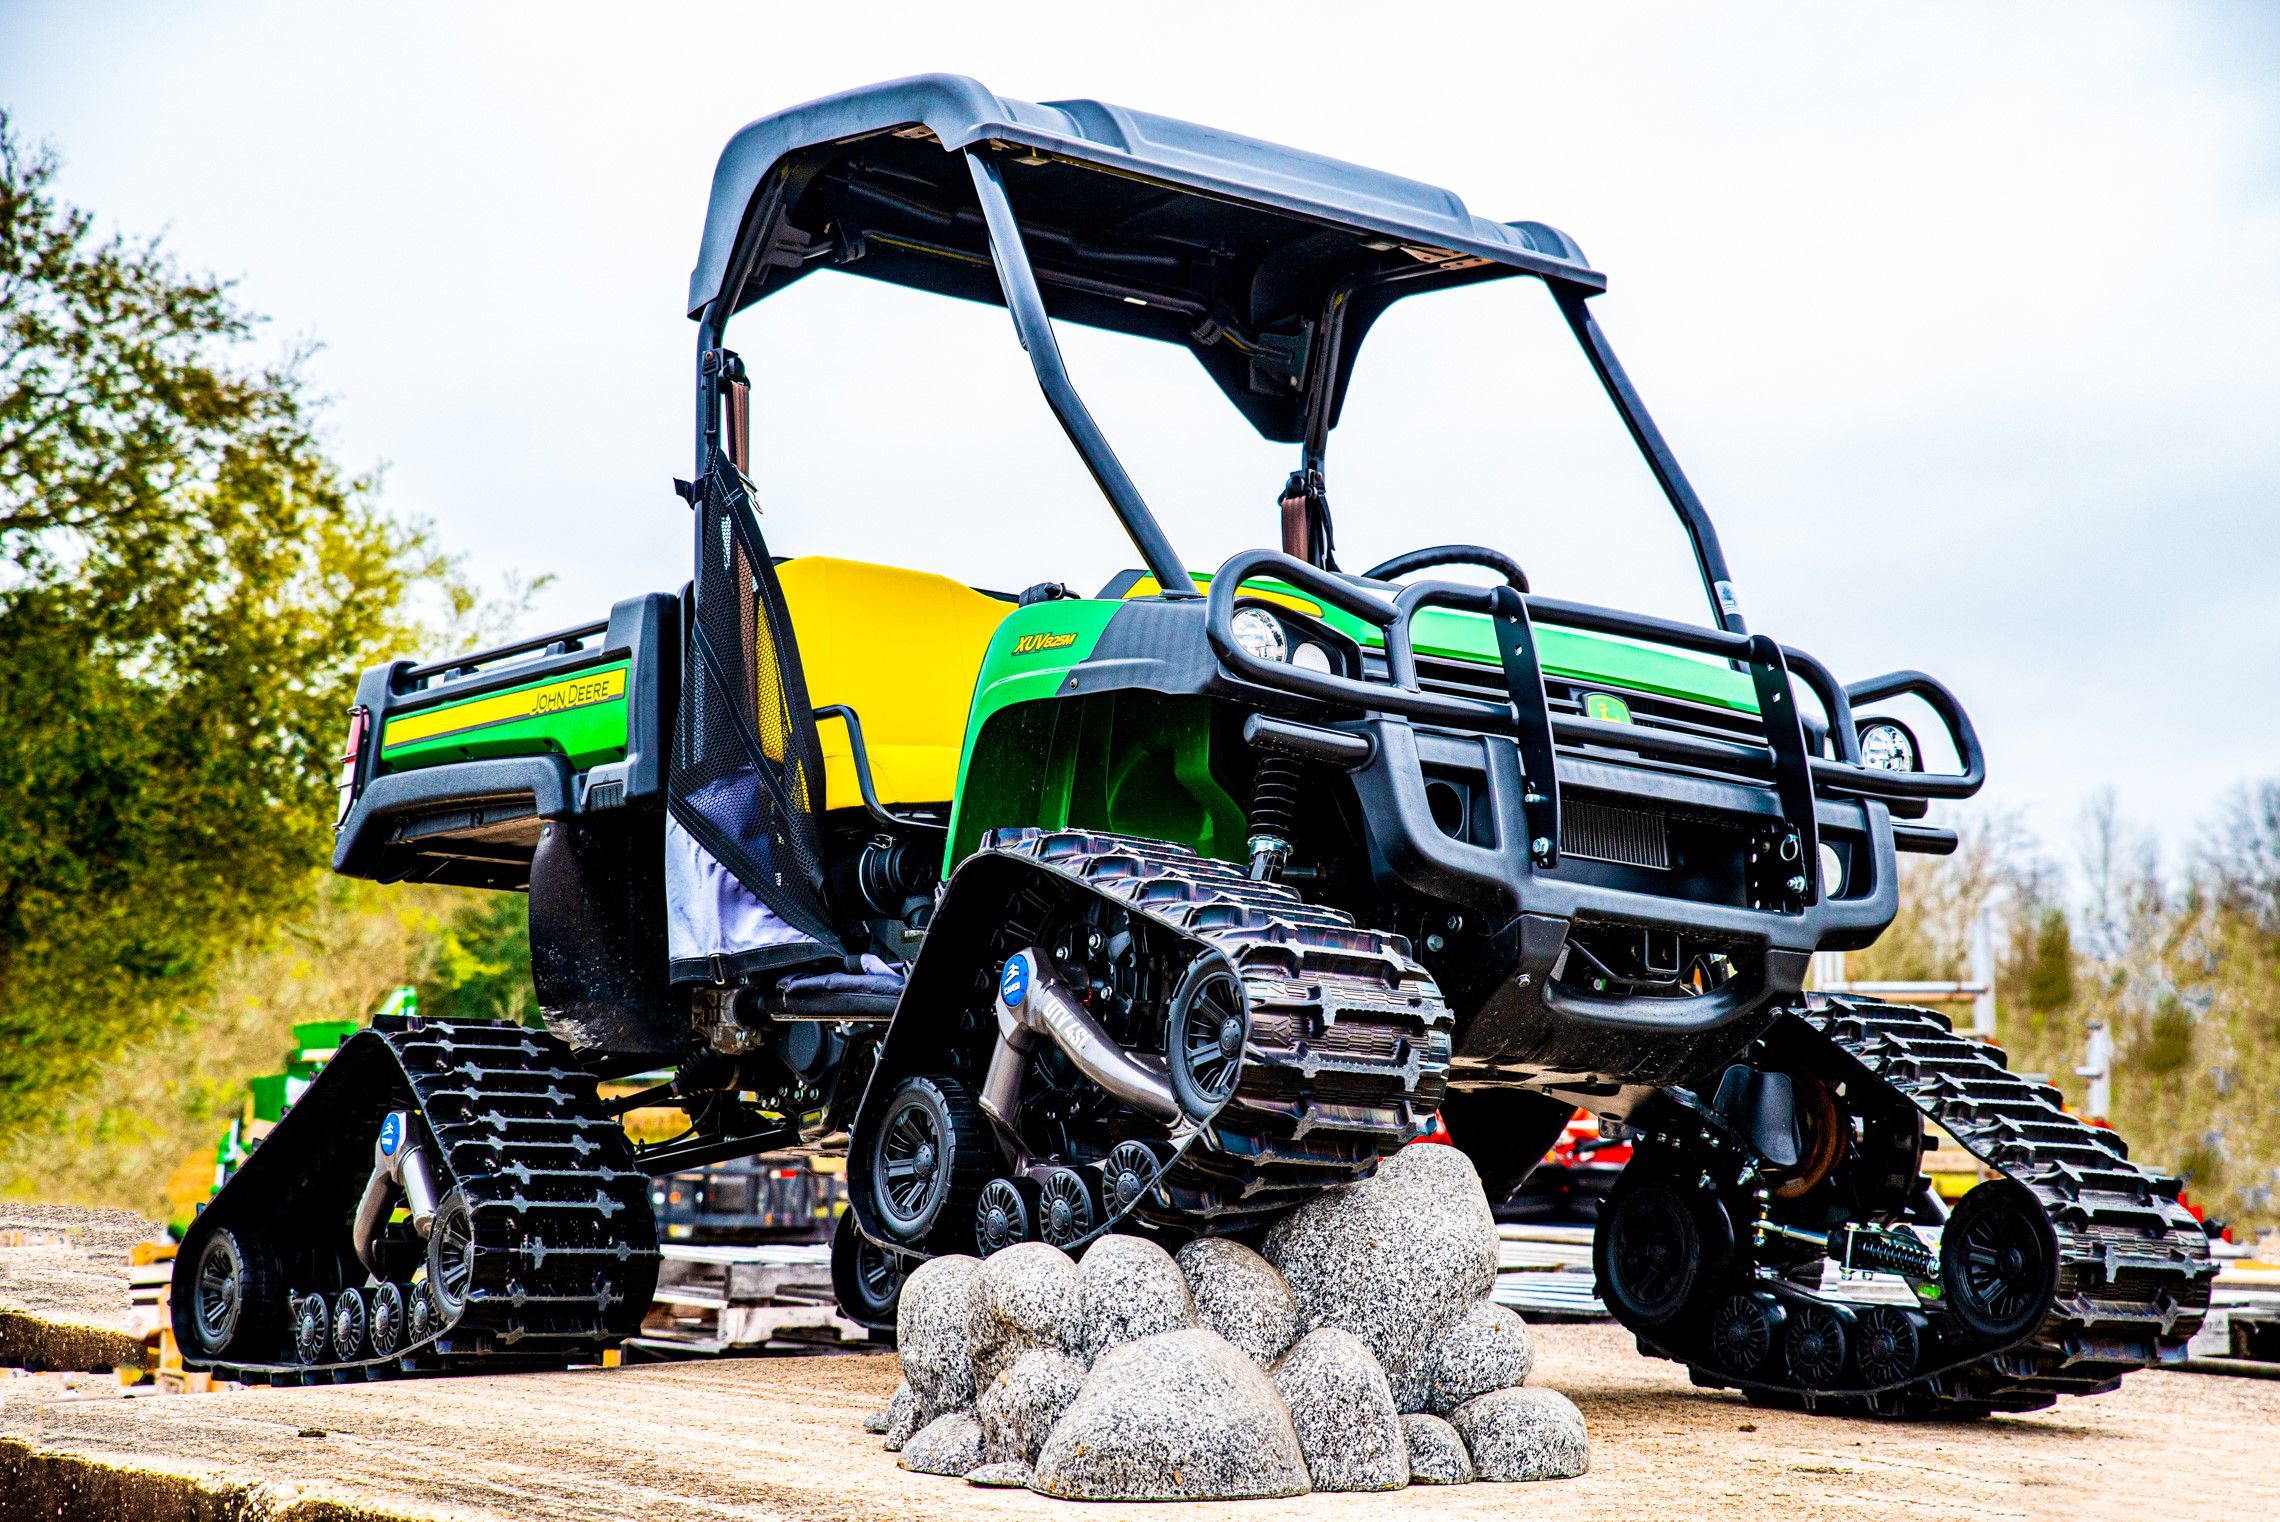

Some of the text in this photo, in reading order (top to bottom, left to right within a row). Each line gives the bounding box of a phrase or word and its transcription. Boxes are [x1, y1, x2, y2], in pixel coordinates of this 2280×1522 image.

[532, 680, 610, 712] JOHN DEERE
[1043, 998, 1074, 1030] UTV
